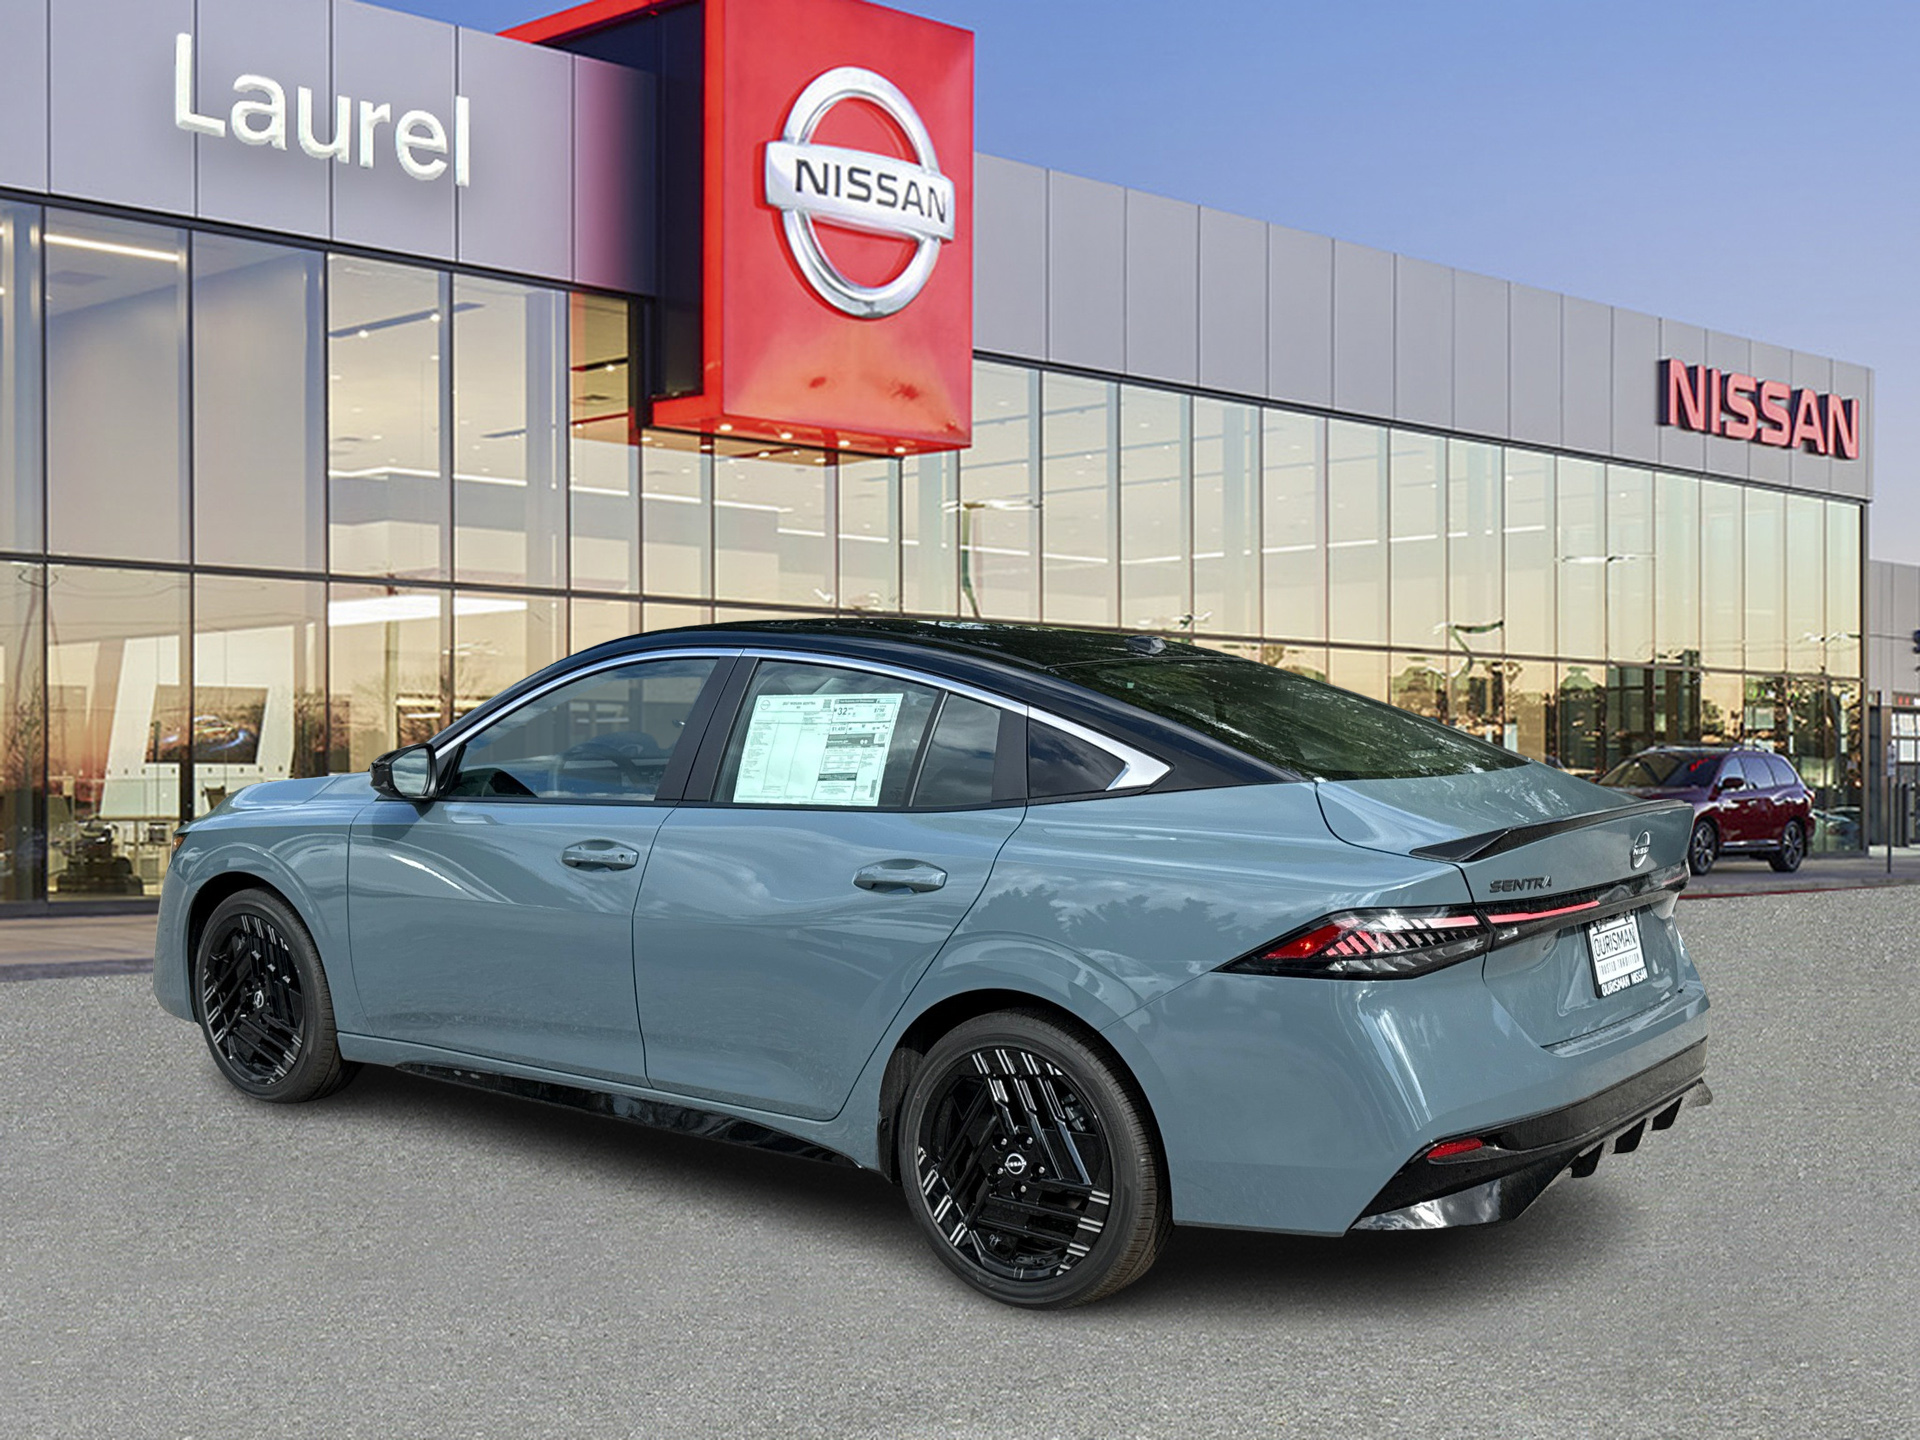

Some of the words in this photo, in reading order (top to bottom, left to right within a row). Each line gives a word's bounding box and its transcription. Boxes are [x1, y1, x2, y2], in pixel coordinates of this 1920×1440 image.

[175, 32, 470, 188] Laurel
[795, 158, 946, 224] NISSAN
[1657, 357, 1860, 461] NISSAN
[1489, 875, 1553, 894] SENTRA
[1594, 926, 1637, 957] OURISMAN
